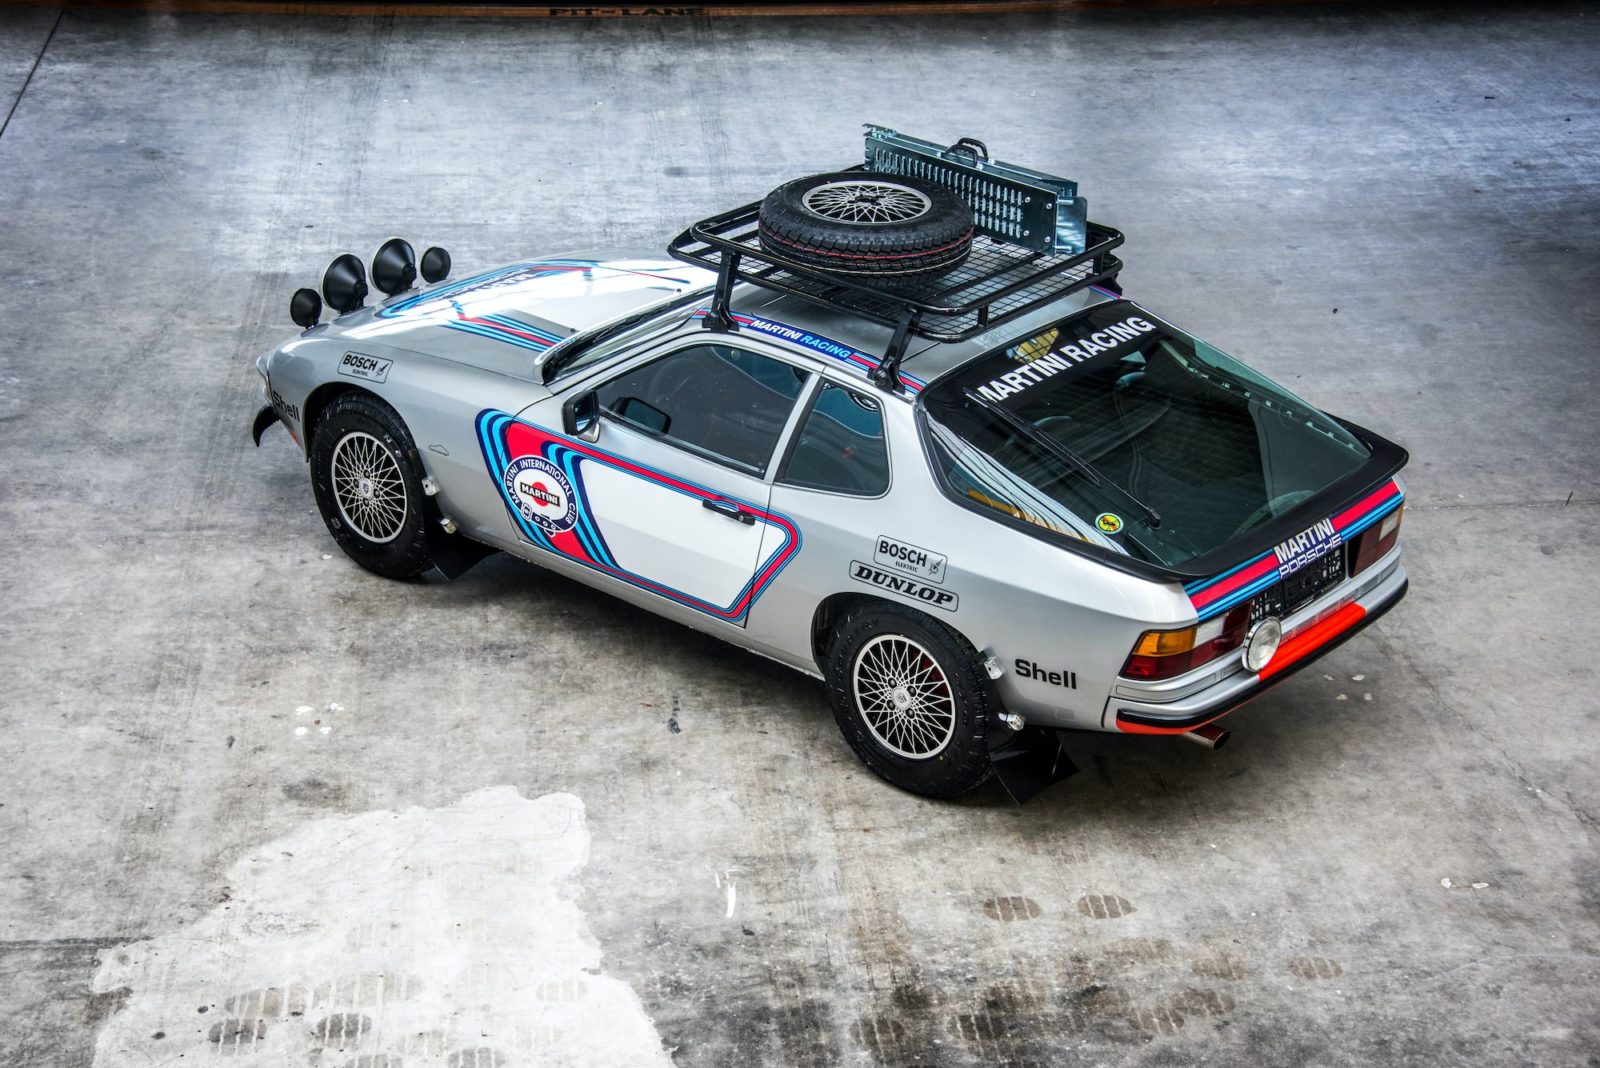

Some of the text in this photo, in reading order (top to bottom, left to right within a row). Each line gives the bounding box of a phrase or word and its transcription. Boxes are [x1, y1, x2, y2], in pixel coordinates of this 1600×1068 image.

[751, 320, 850, 358] MARTINI RACING
[1060, 317, 1156, 362] RACING
[342, 354, 378, 371] BOSCH
[273, 390, 300, 422] Shell
[506, 459, 576, 525] MARTINI INTERNATIONAL CLUB
[522, 484, 559, 505] MARTINI
[879, 540, 927, 567] BOSCH
[1273, 517, 1336, 564] MARTINI
[1278, 533, 1342, 579] PORSCHE
[854, 565, 954, 605] DUNLOP
[1015, 658, 1077, 689] Shell
